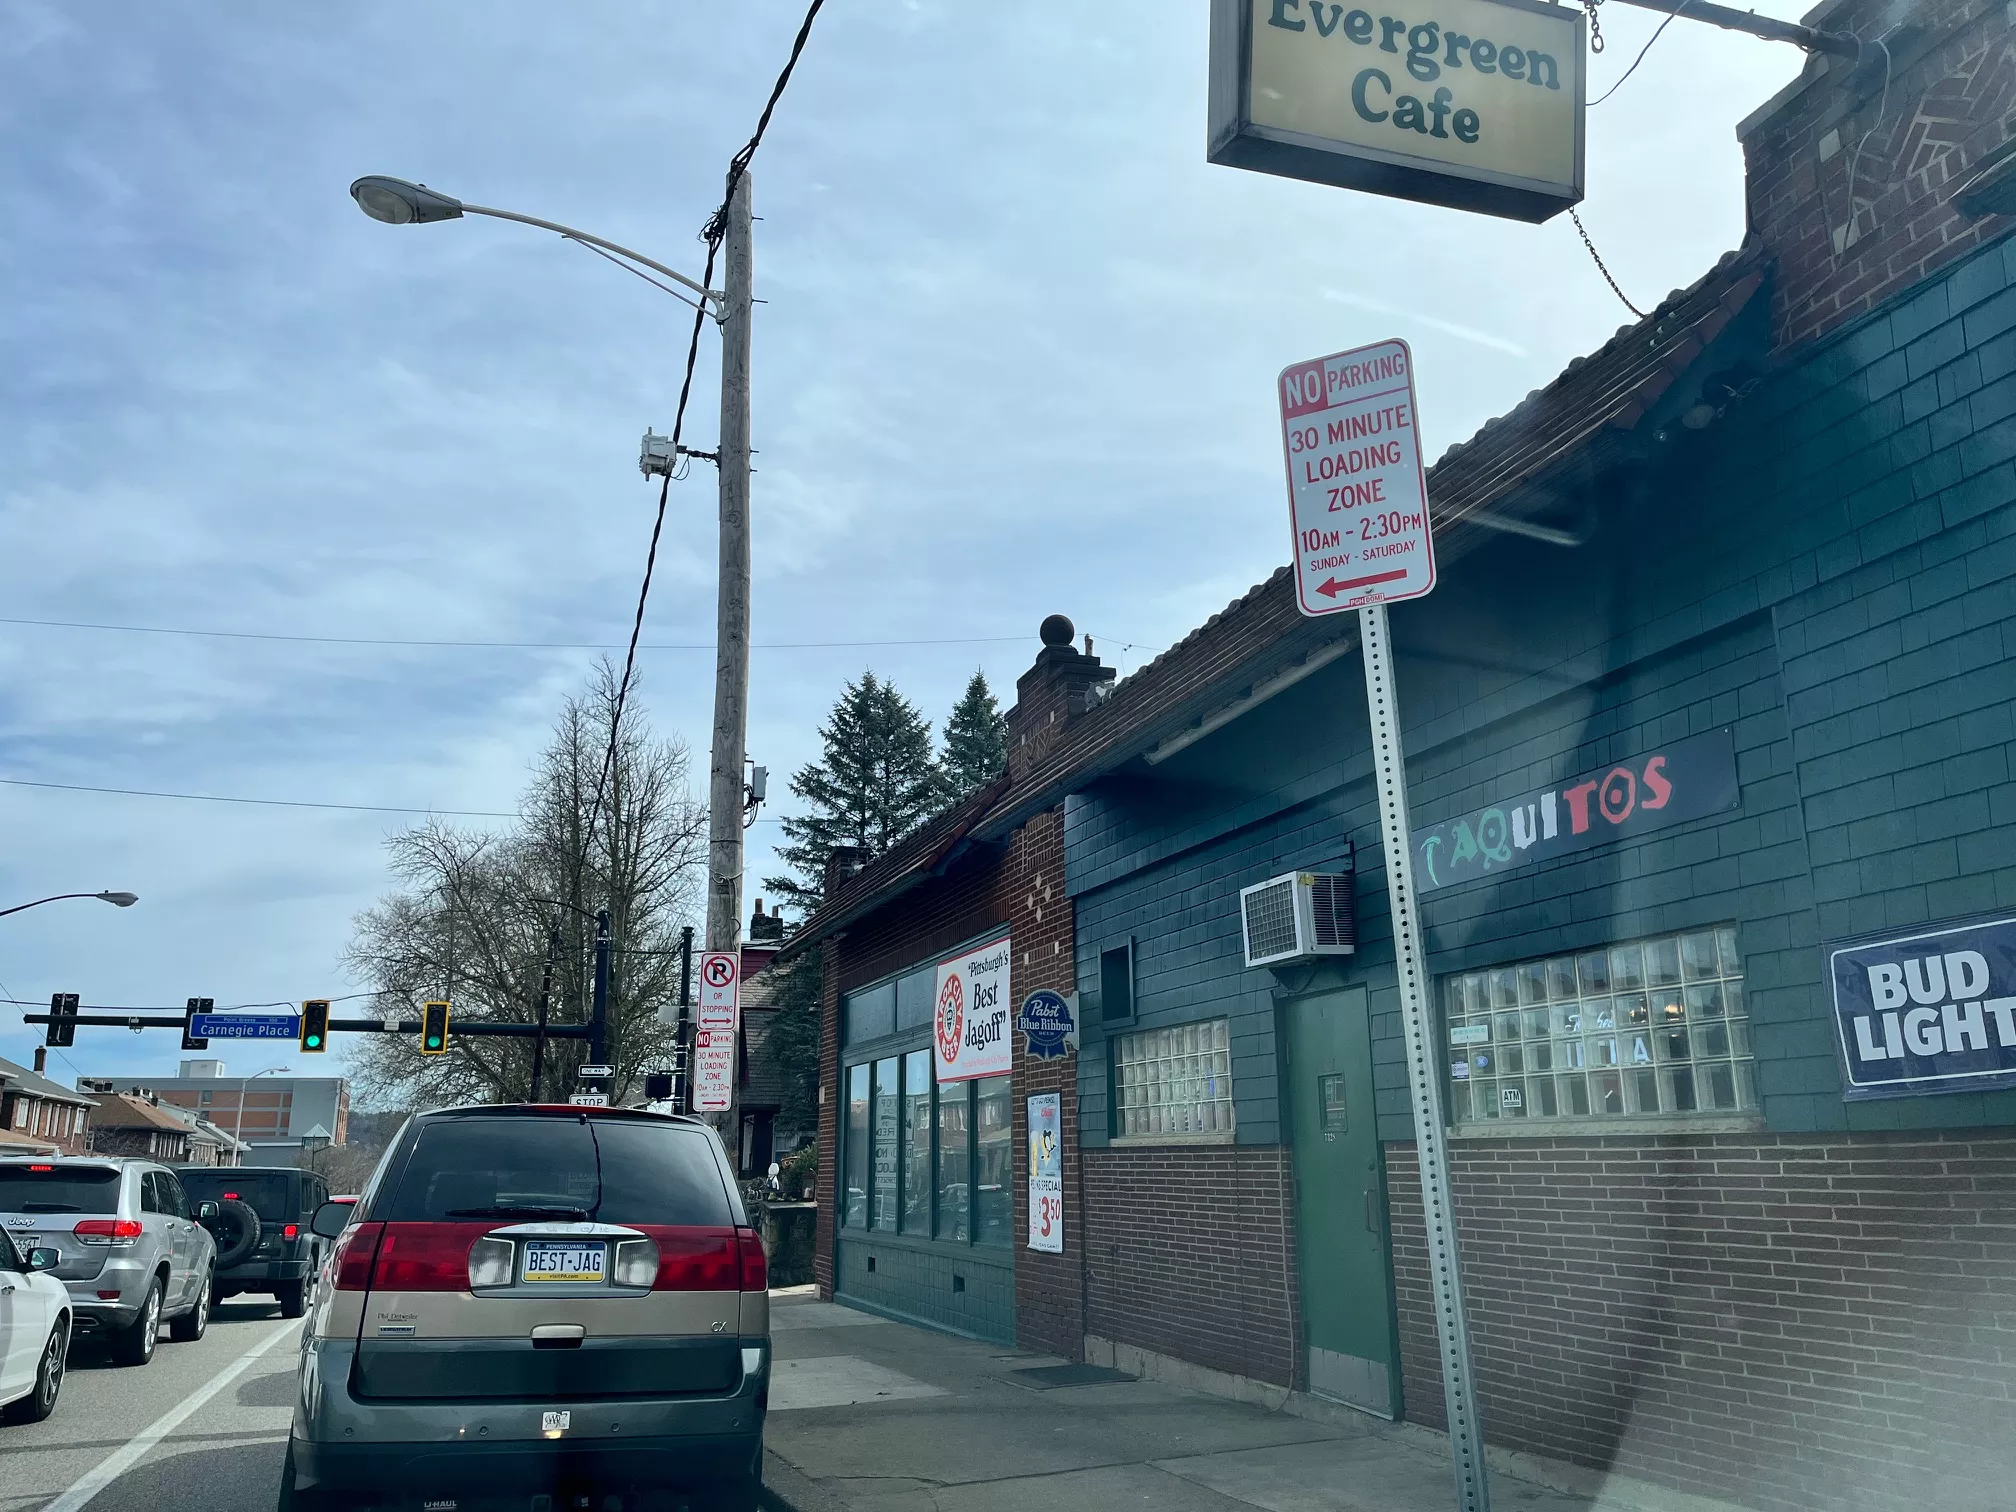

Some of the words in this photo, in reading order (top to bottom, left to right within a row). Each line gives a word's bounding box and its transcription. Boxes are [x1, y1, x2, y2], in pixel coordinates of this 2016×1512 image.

[1268, 0, 1560, 90] Evergreen
[1351, 68, 1480, 144] Cafe
[1284, 368, 1321, 409] NO
[1327, 353, 1404, 392] PARKING
[1291, 427, 1319, 453] 30
[1327, 404, 1410, 445] MINUTE
[1306, 441, 1401, 483] LOADING
[1327, 478, 1386, 512] ZONE
[1301, 528, 1340, 553] 10AM
[1360, 511, 1421, 540] 2:30PM
[1310, 553, 1350, 572] SUNDAY
[1362, 540, 1416, 561] SATURDAY
[1867, 950, 1990, 1011] BUD
[713, 992, 723, 1000] OR
[973, 979, 998, 1010] Best
[702, 1005, 733, 1013] STOPPING
[1030, 999, 1060, 1017] Pabst
[200, 1024, 254, 1037] Carnegie
[258, 1025, 290, 1036] Place
[1019, 1017, 1040, 1030] Blue
[1040, 1018, 1073, 1031] Ribbon
[1853, 996, 2016, 1062] LIGHT
[698, 1033, 709, 1045] NO
[710, 1035, 732, 1043] PARKING
[697, 1051, 706, 1060] 30
[708, 1051, 731, 1060] MINUTE
[700, 1062, 727, 1070] LOADING
[704, 1072, 722, 1081] ZONE
[1503, 1090, 1520, 1101] ATM
[1040, 1180, 1062, 1191] SPECIAL
[8, 1216, 36, 1228] Jeep
[528, 1251, 601, 1272] BEST-JAG
[711, 1321, 727, 1332] CX
[423, 1500, 458, 1509] U-HAUL
